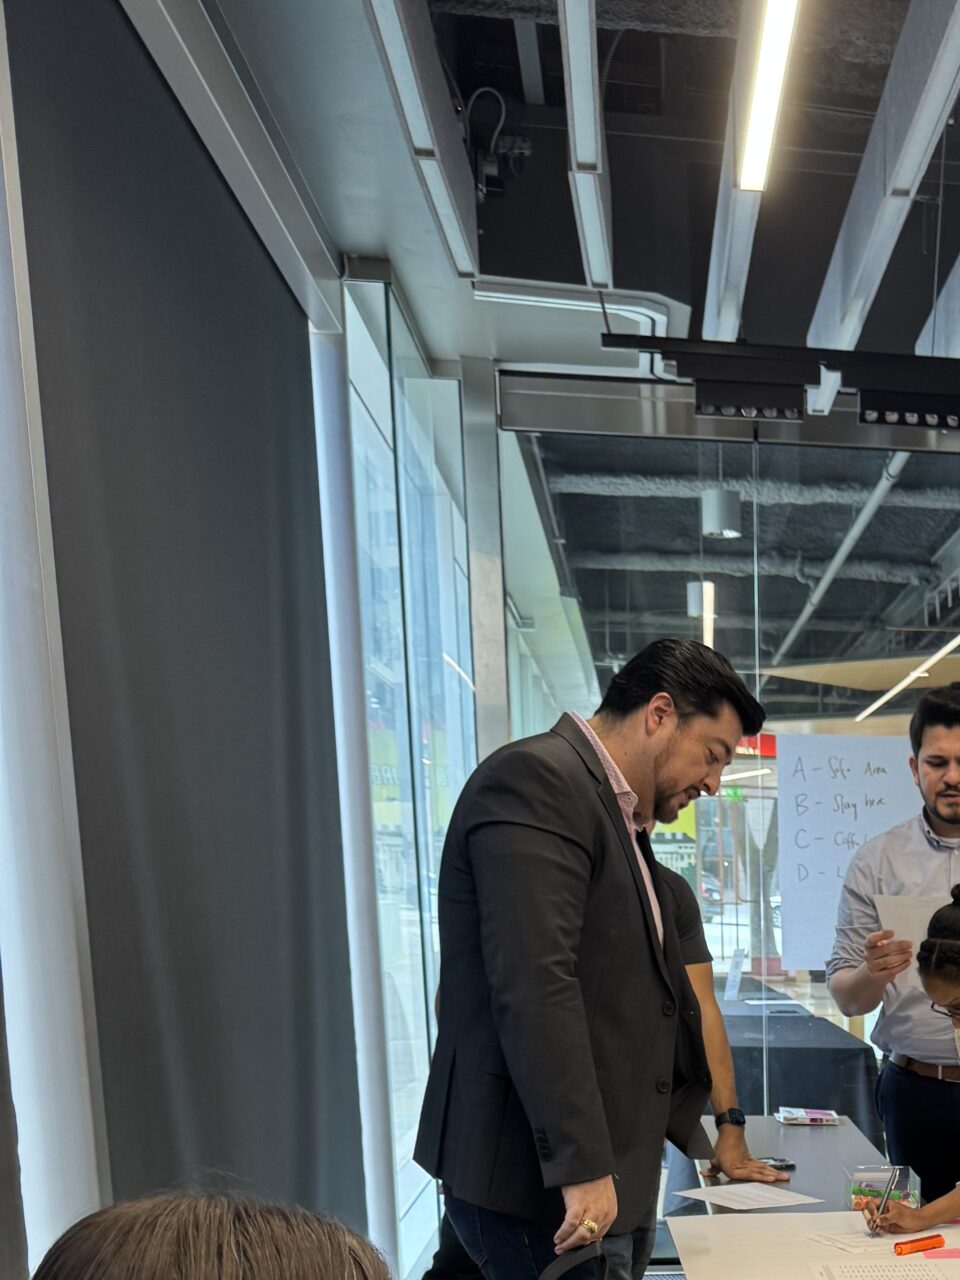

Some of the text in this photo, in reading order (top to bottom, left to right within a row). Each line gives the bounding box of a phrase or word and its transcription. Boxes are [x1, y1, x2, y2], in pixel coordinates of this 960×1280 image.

[792, 756, 807, 783] A
[794, 793, 810, 816] B
[794, 828, 810, 850] C
[797, 862, 809, 883] D
